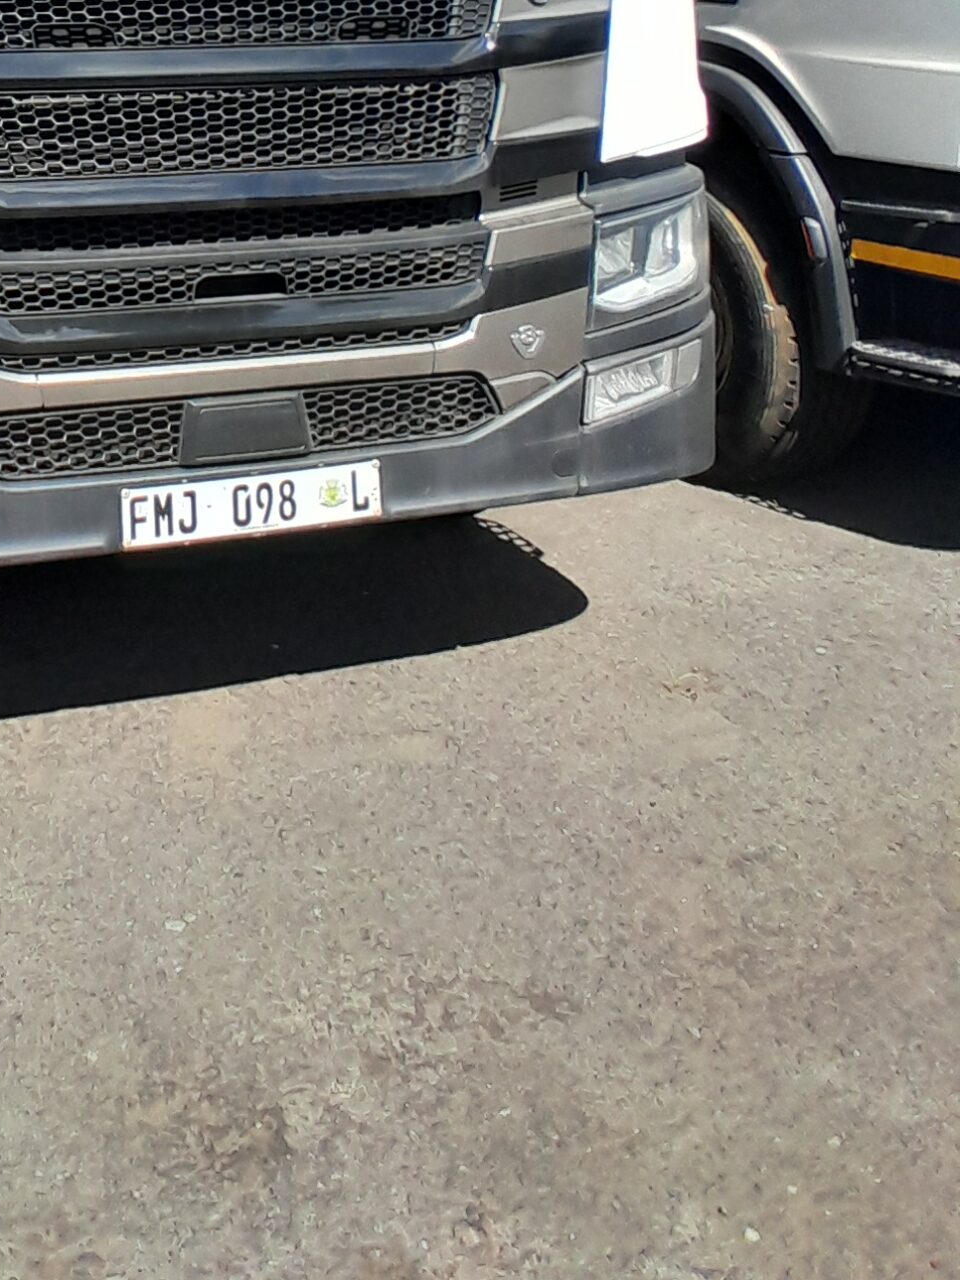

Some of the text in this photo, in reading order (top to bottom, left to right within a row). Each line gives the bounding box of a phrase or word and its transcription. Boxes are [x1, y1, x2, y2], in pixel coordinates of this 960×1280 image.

[129, 469, 370, 540] FMJ 098 L
